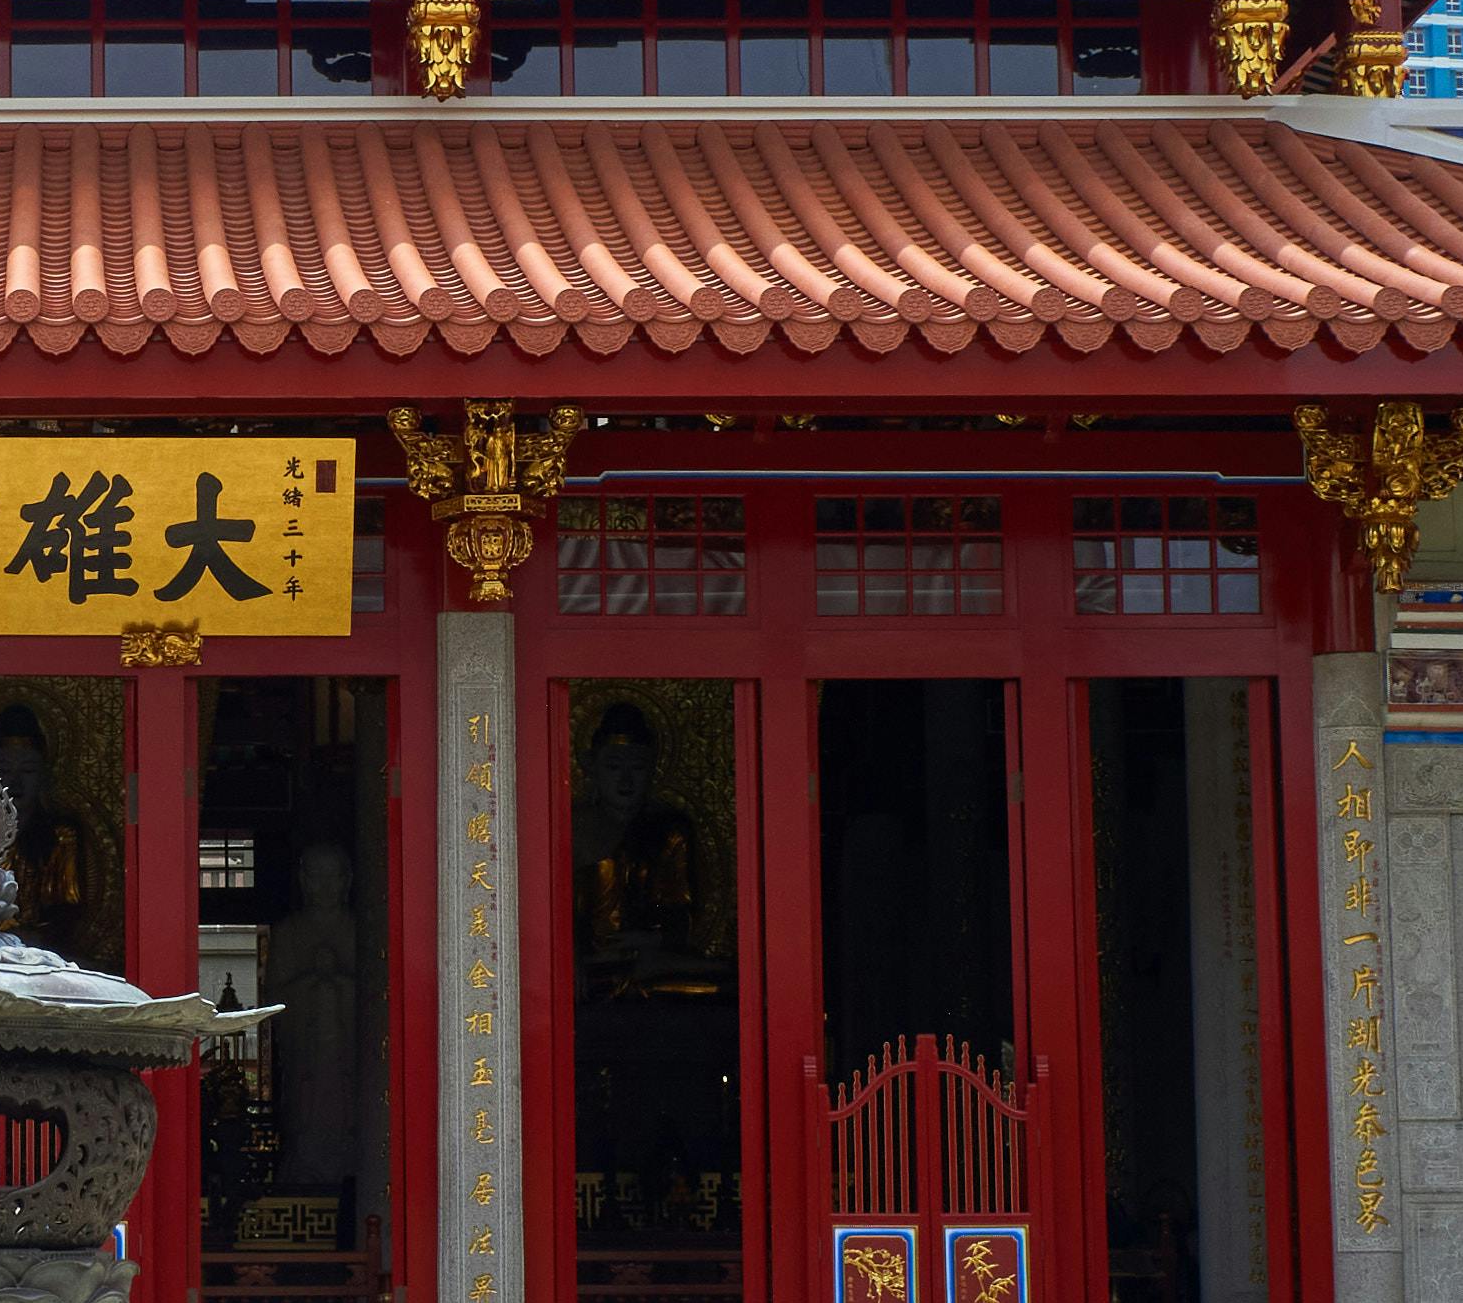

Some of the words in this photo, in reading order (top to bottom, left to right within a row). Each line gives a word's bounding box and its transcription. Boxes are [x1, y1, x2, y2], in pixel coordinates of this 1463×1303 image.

[281, 456, 306, 602] 光緒三十年
